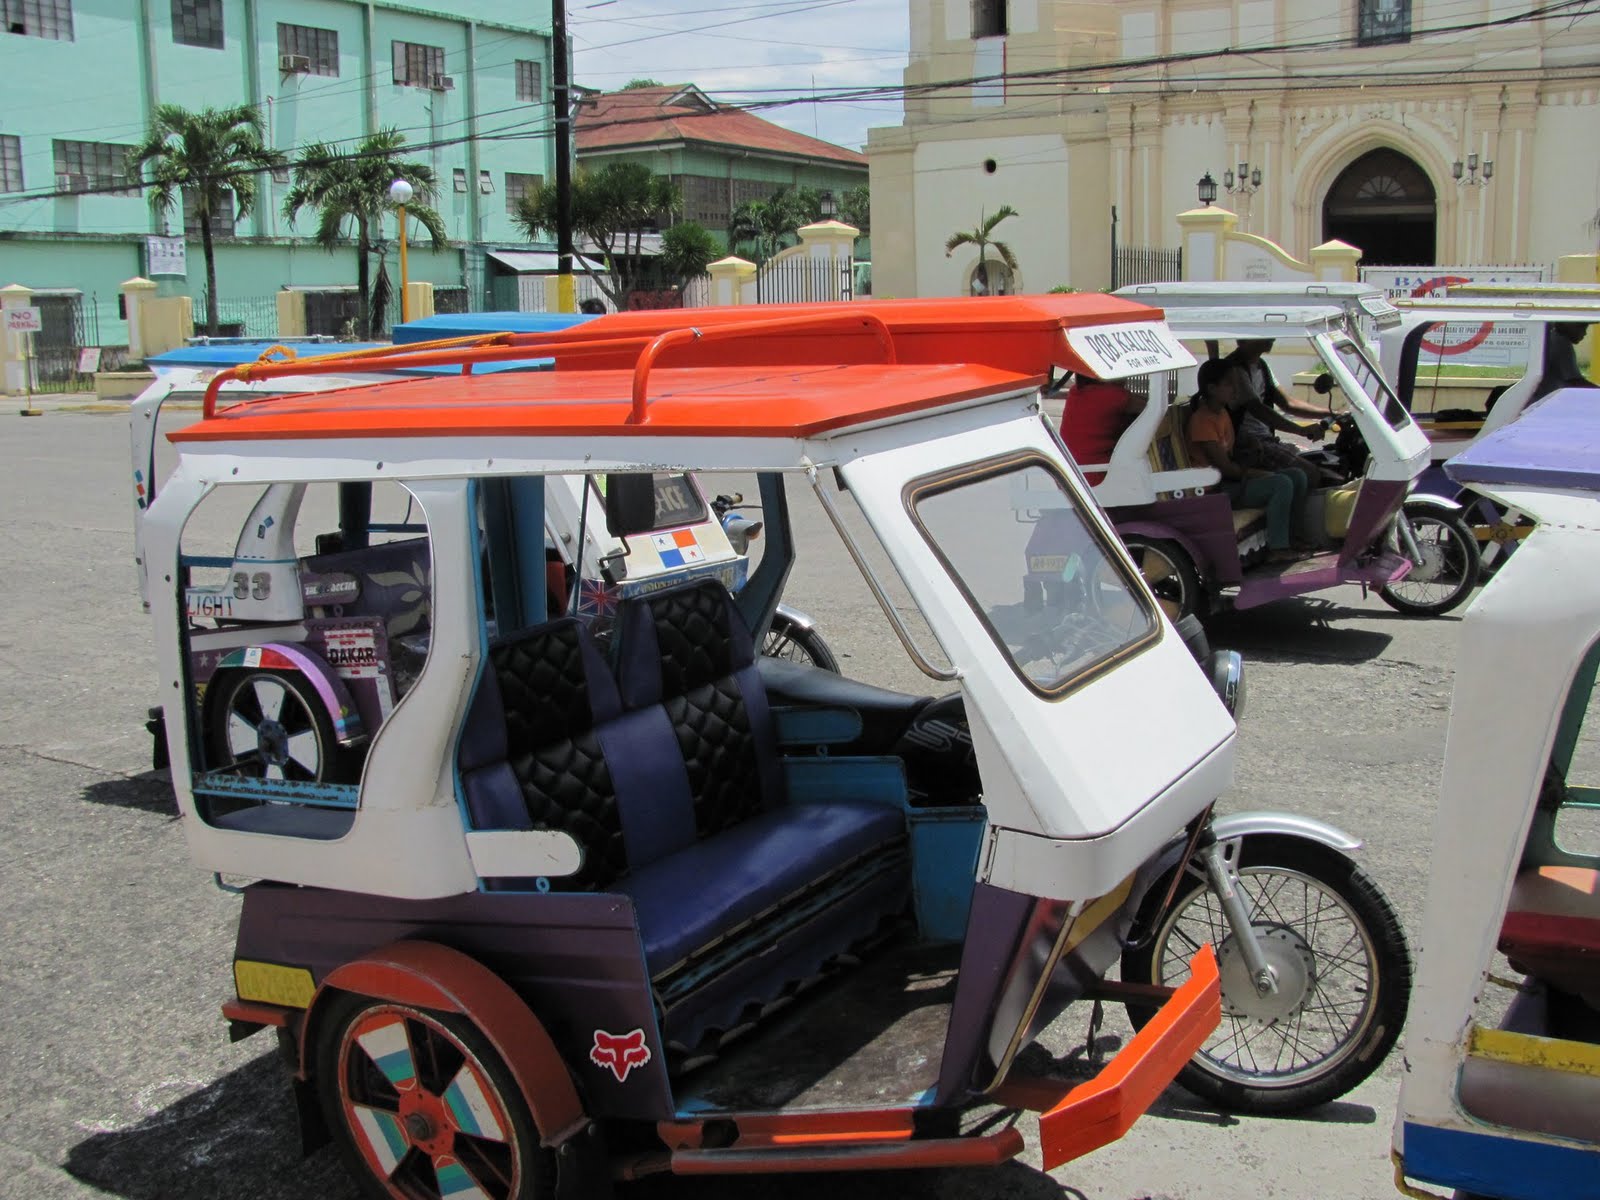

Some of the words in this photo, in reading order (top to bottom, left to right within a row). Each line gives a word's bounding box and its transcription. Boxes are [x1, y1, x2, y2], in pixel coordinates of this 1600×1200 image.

[11, 311, 31, 320] NO
[1111, 329, 1172, 359] KALIBO
[1126, 358, 1143, 369] FOR
[1142, 355, 1161, 366] HIRE
[233, 571, 272, 600] 33
[186, 595, 234, 617] LIGHT
[328, 647, 376, 665] DAKAR
